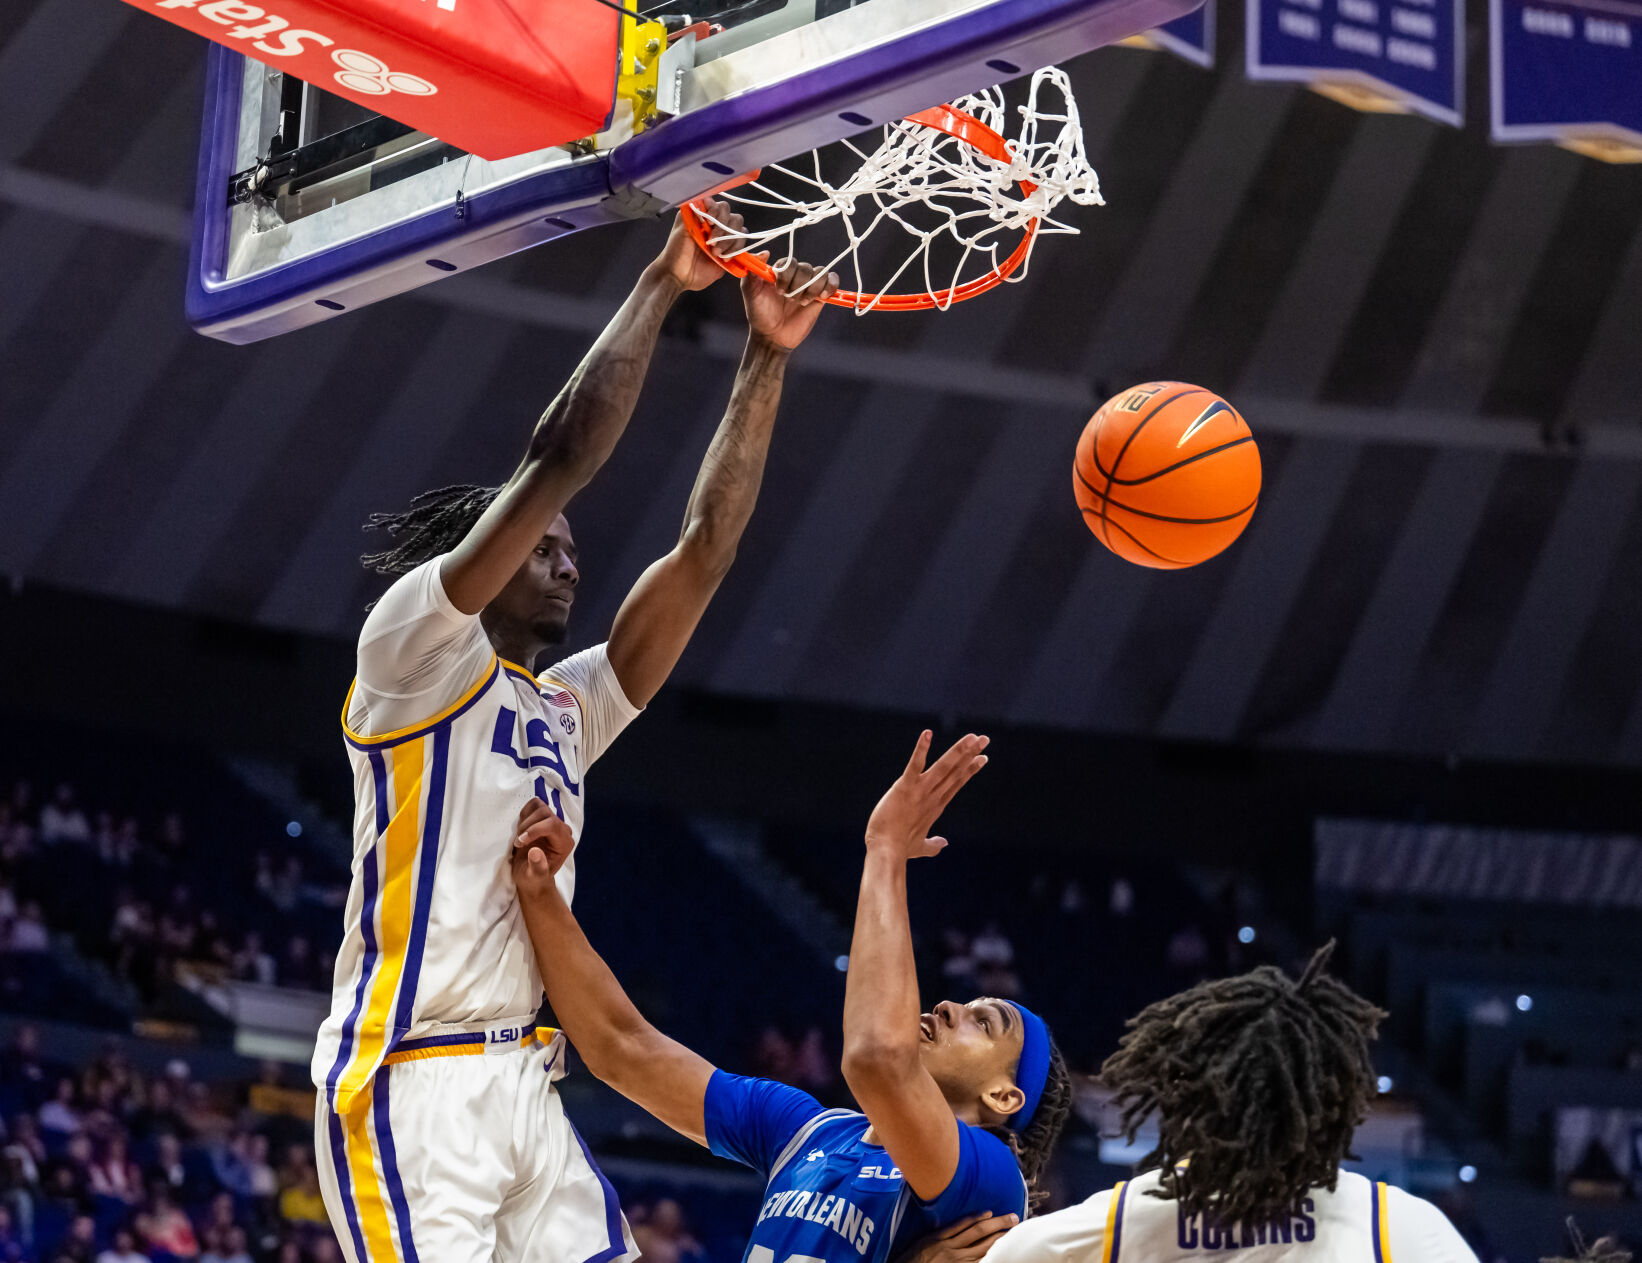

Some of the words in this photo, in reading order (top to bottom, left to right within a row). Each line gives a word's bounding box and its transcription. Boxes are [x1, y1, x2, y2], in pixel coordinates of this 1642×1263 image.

[491, 705, 580, 797] LSU
[490, 1027, 519, 1044] LSU
[756, 1190, 800, 1227] EW
[785, 1190, 875, 1256] ORLEANS
